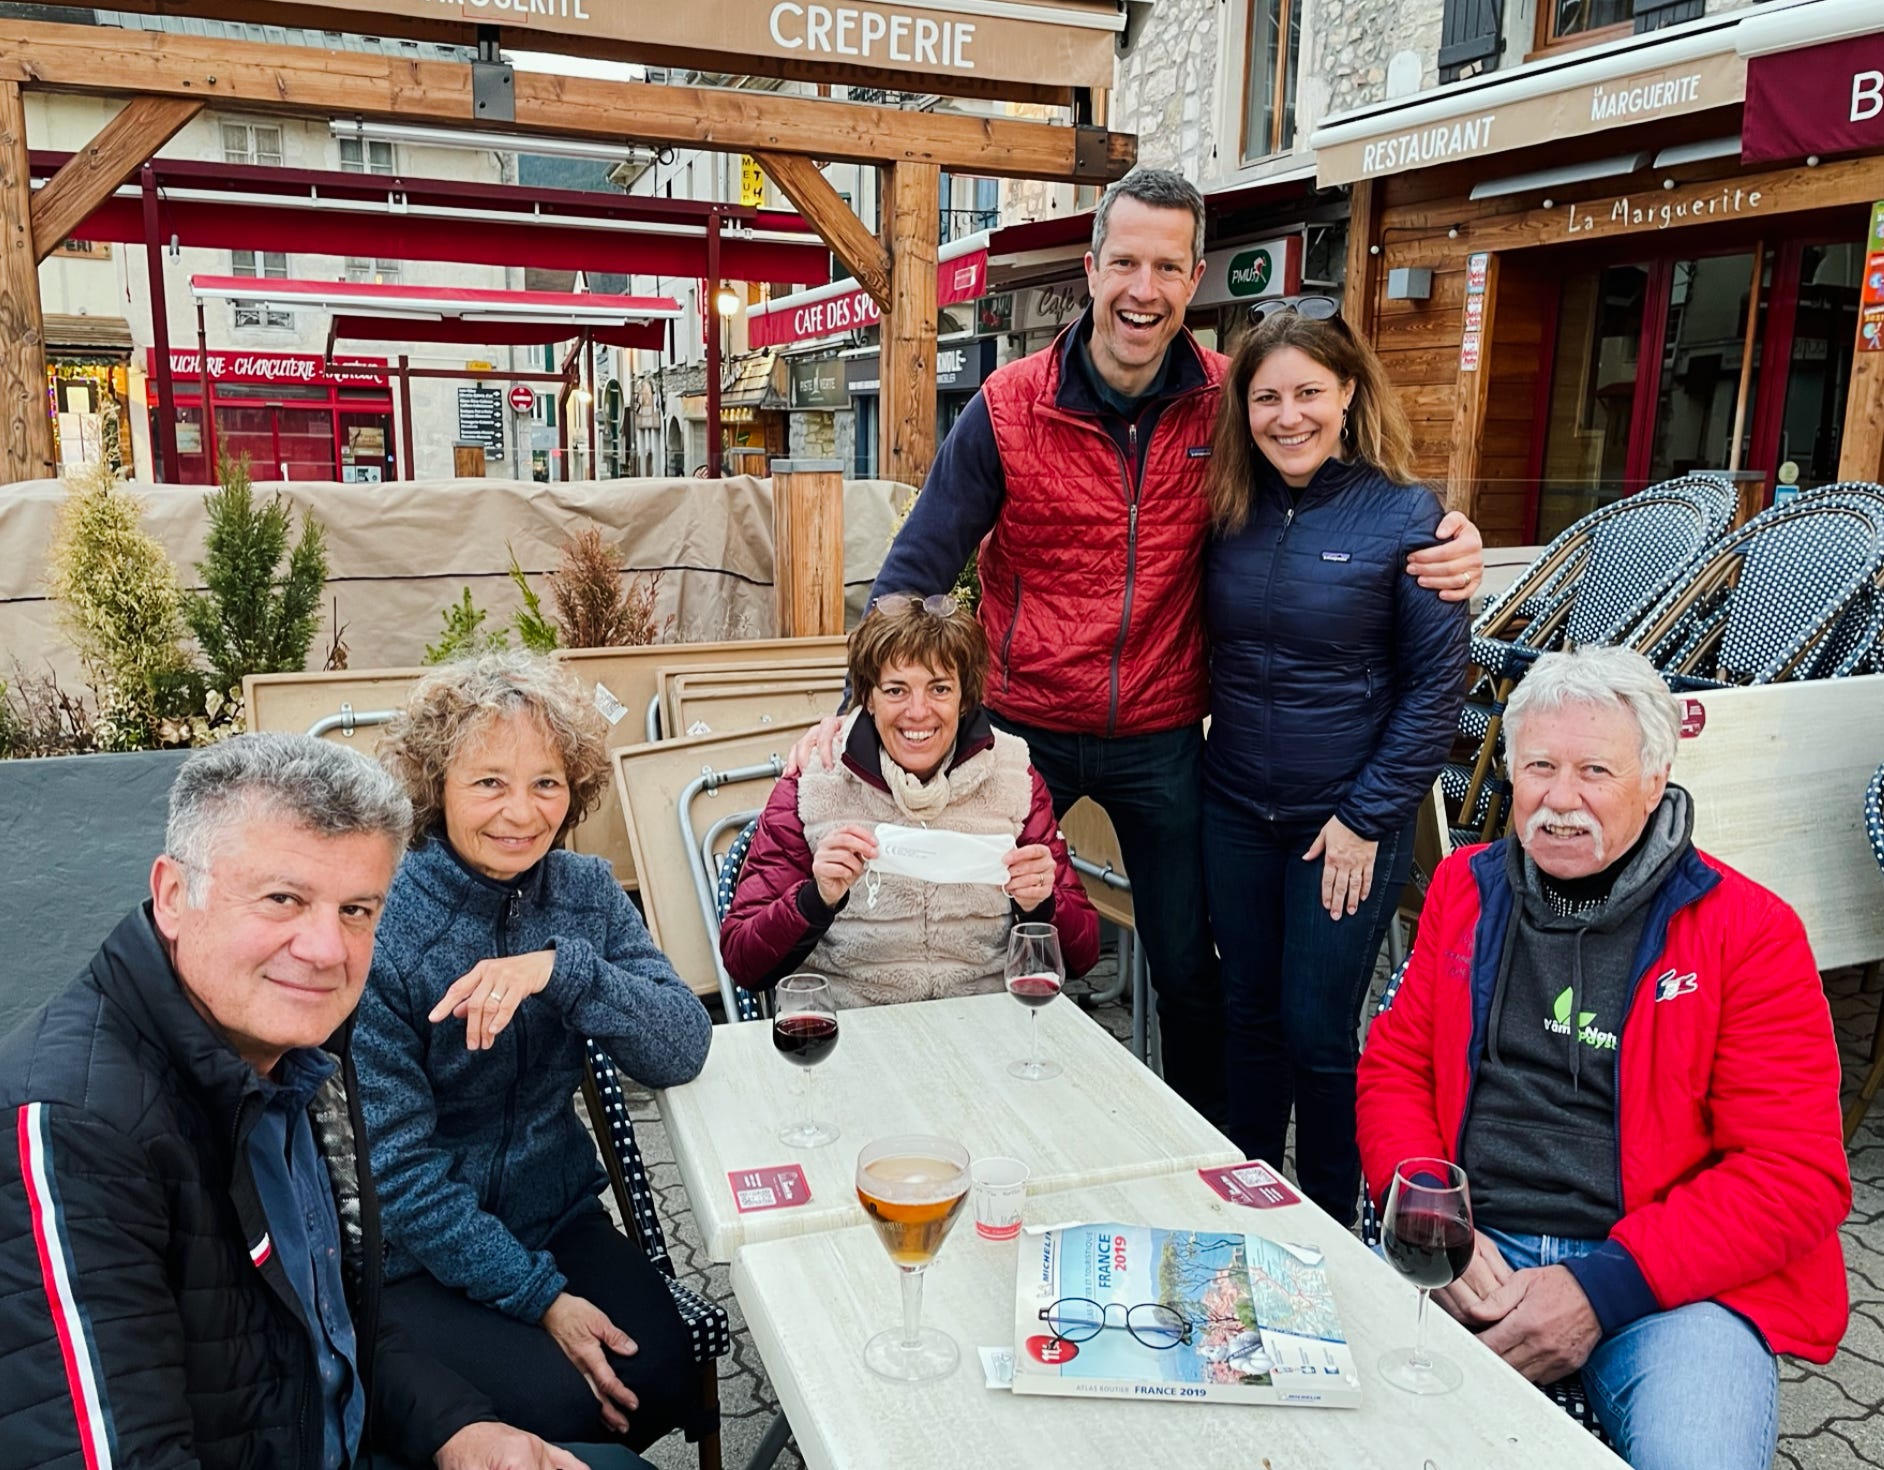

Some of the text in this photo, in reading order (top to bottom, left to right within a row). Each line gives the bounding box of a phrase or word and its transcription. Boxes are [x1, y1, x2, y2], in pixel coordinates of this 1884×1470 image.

[770, 2, 976, 68] CREPERIE
[1591, 74, 1701, 121] MARGUERITE
[1594, 86, 1604, 97] LA
[1363, 115, 1495, 173] RESTAURANT
[1568, 188, 1761, 233] La Marguerite
[1232, 267, 1254, 284] PMU
[794, 304, 823, 335] CAFE
[827, 297, 850, 329] DES
[169, 355, 226, 378] UCHRIE
[234, 356, 316, 381] CHARCUTERIE
[1098, 1233, 1112, 1288] FRANCE
[1114, 1235, 1127, 1271] 2019
[1075, 1384, 1207, 1397] ATLAS ROUTIER FRANCE 2019
